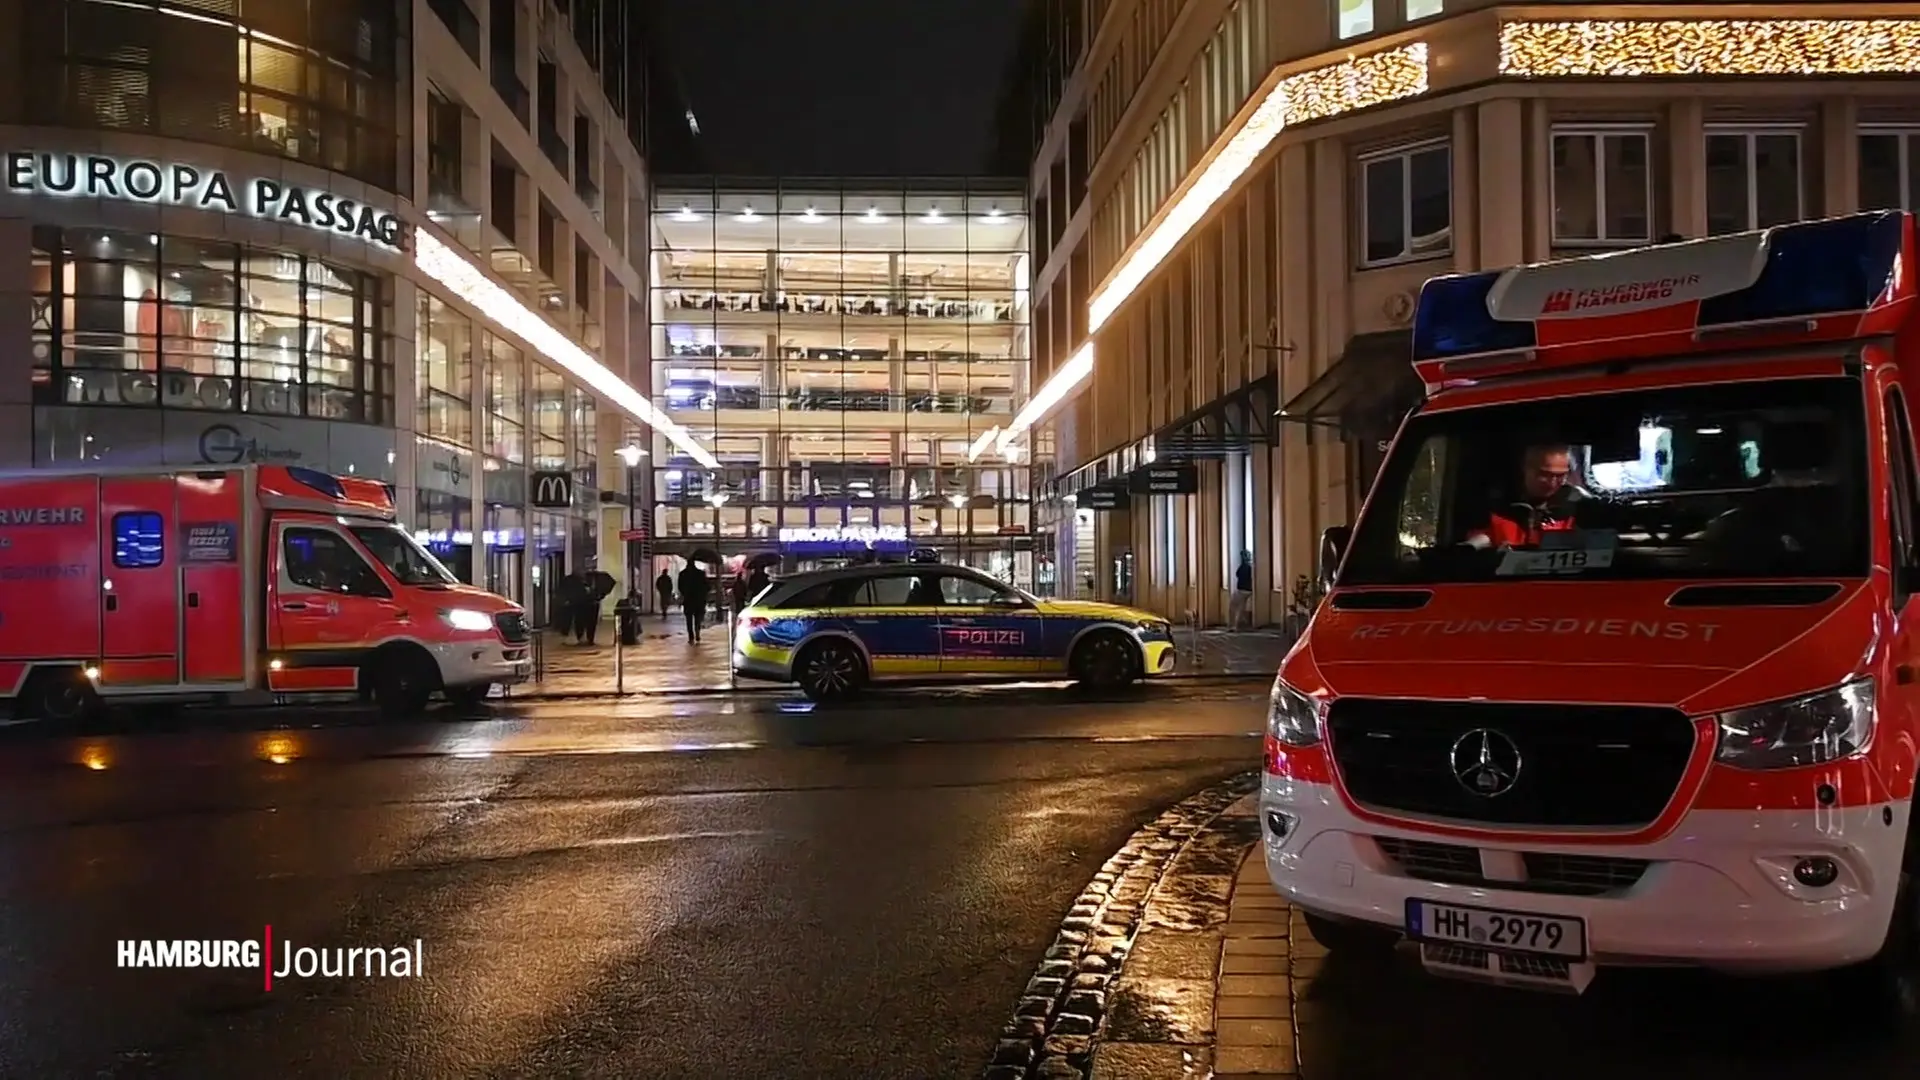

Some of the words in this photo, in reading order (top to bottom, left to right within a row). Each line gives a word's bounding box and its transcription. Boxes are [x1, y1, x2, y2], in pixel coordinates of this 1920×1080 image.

[7, 152, 237, 210] EUROPA
[255, 179, 412, 253] PASSAGE
[1577, 273, 1701, 298] FEUERWEHR
[1574, 287, 1675, 310] HAMBURG
[958, 630, 1025, 645] POLIZEI
[1350, 617, 1722, 642] RETTUNGSDIENST
[1433, 907, 1470, 939] HH
[1488, 914, 1564, 950] 2979
